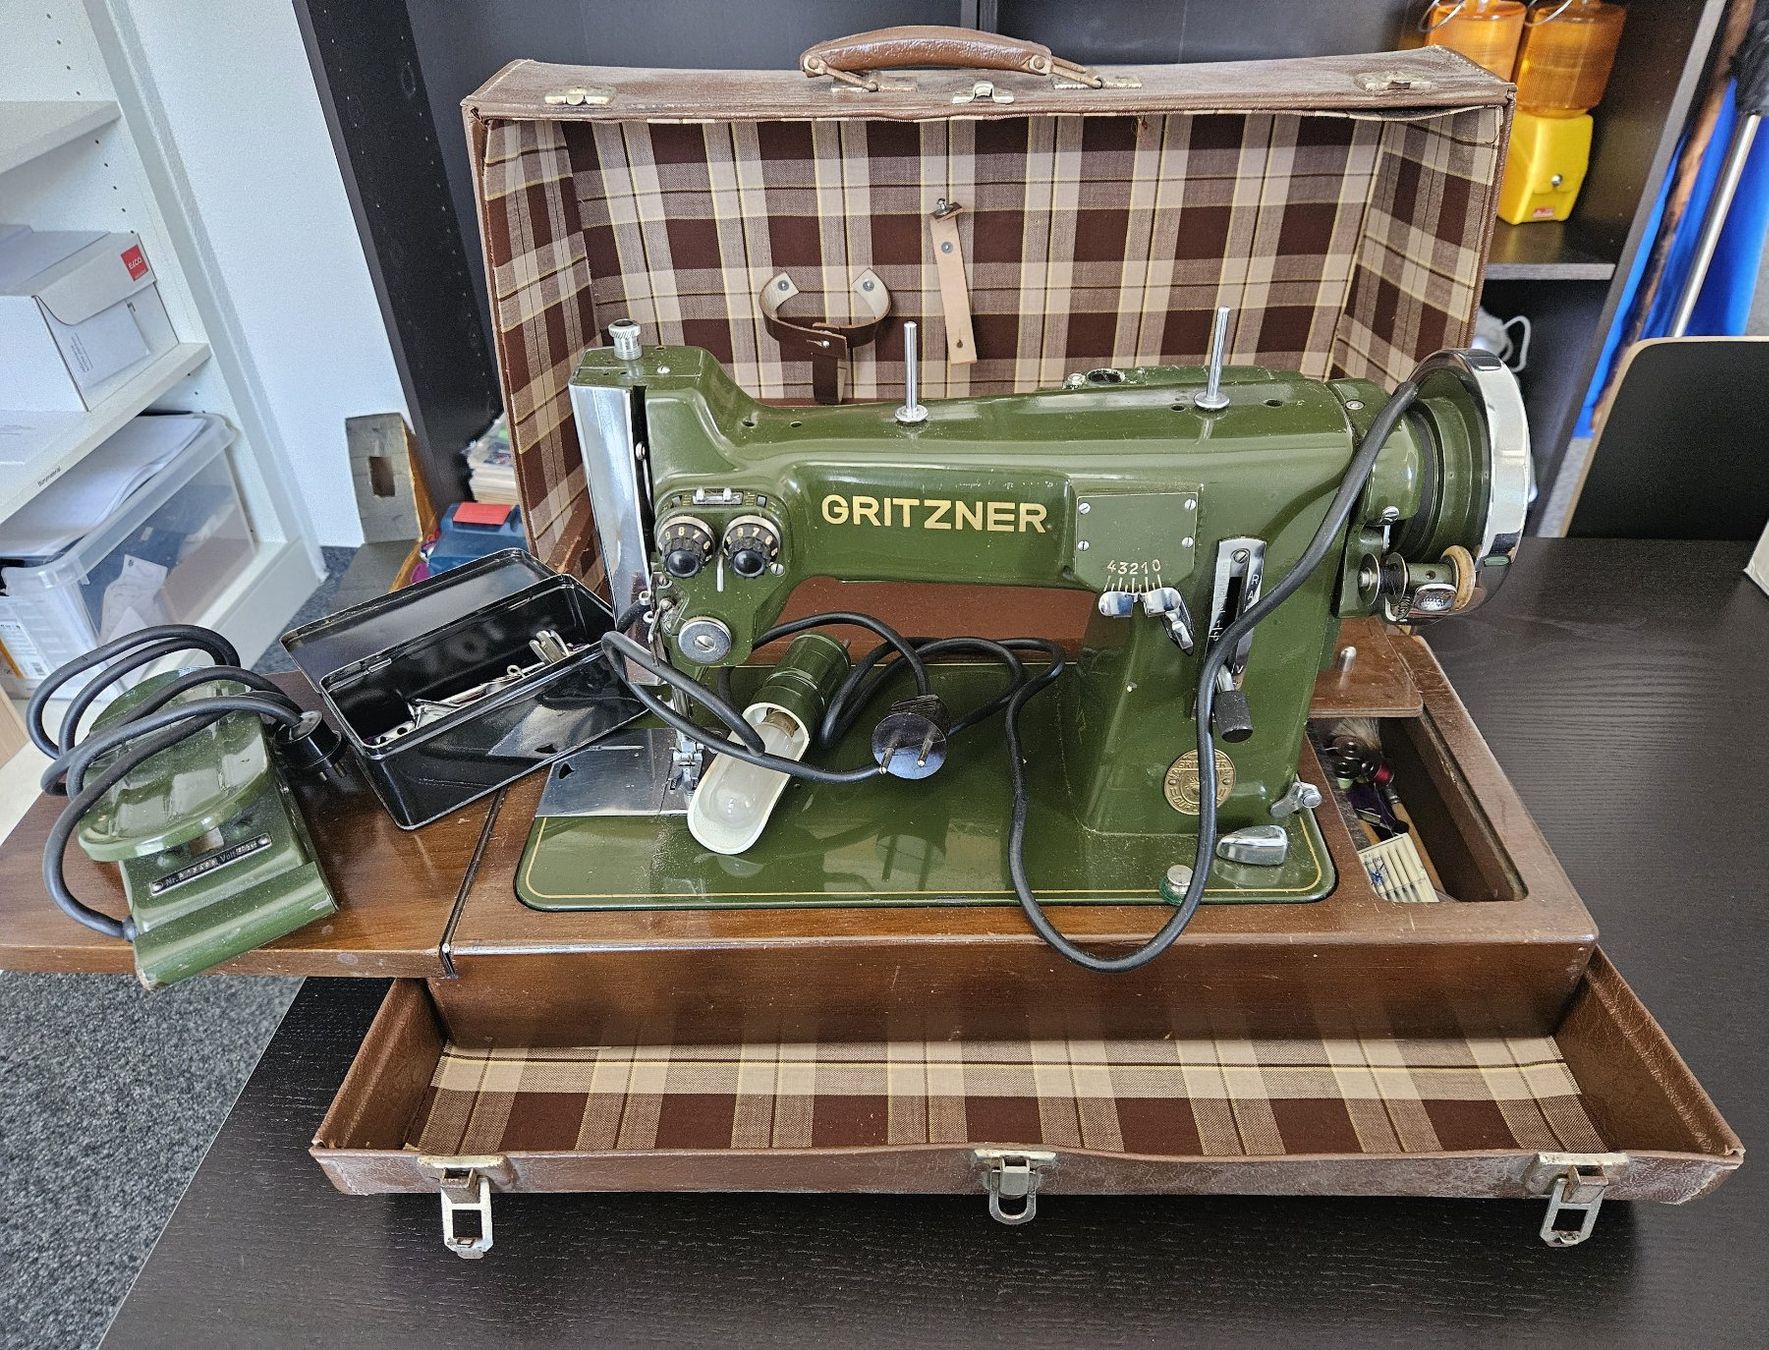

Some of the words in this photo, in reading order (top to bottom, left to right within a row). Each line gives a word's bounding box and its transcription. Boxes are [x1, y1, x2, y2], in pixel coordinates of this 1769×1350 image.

[821, 494, 1048, 533] GRITZNER
[678, 526, 685, 536] 8
[693, 530, 701, 539] 7
[752, 527, 760, 537] 7
[1251, 574, 1260, 585] R
[1247, 590, 1254, 601] A
